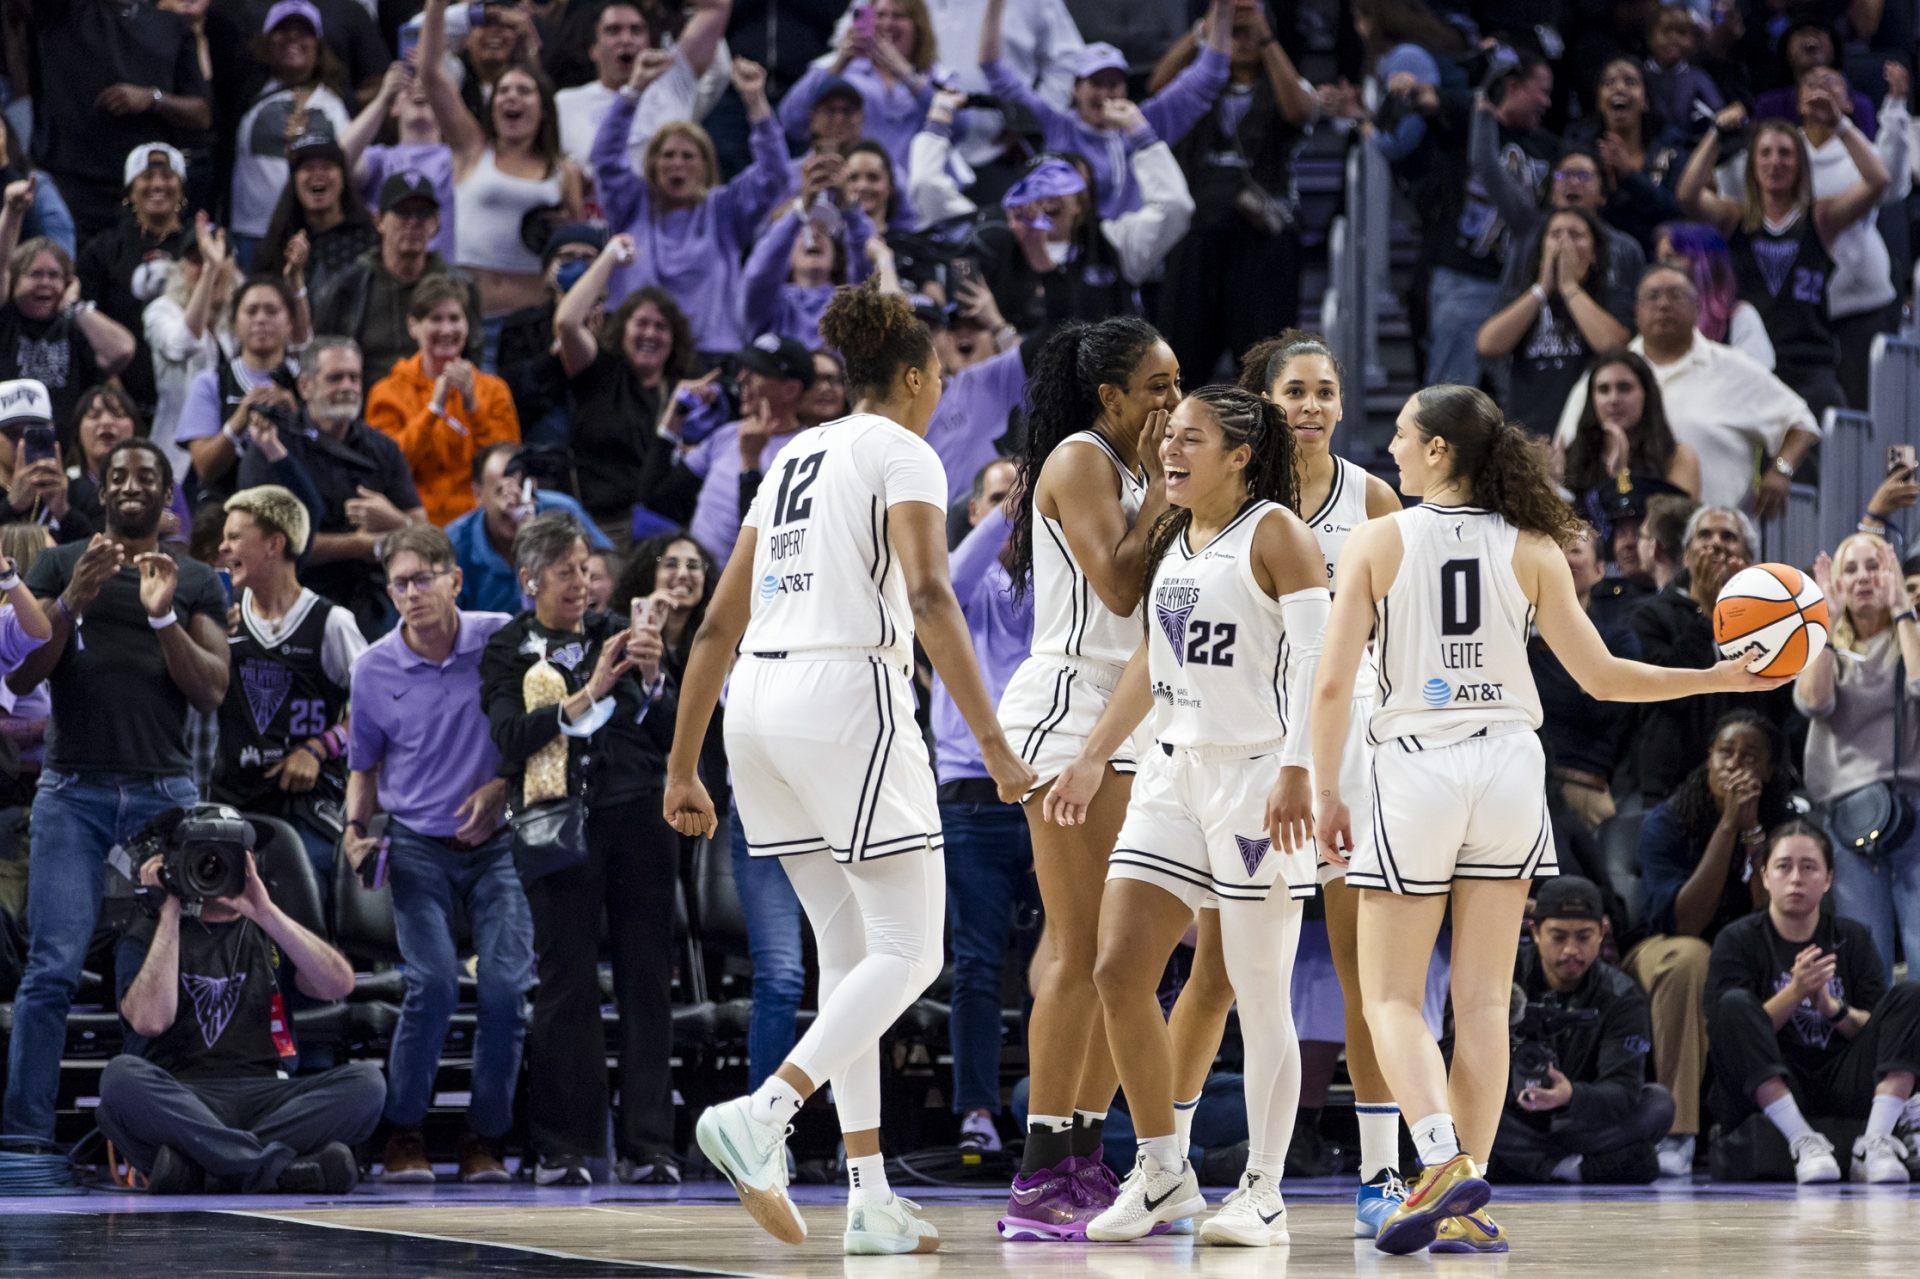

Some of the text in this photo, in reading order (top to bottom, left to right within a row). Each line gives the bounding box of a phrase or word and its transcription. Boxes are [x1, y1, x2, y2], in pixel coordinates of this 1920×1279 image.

[773, 449, 828, 528] 12
[770, 527, 807, 562] RUPERT
[776, 572, 814, 594] AT&T
[1156, 586, 1200, 610] VALKYRIES
[1441, 558, 1481, 636] 0
[1187, 620, 1237, 667] 22
[1441, 642, 1484, 669] LEITE
[1454, 683, 1503, 701] AT&T
[289, 699, 327, 736] 25
